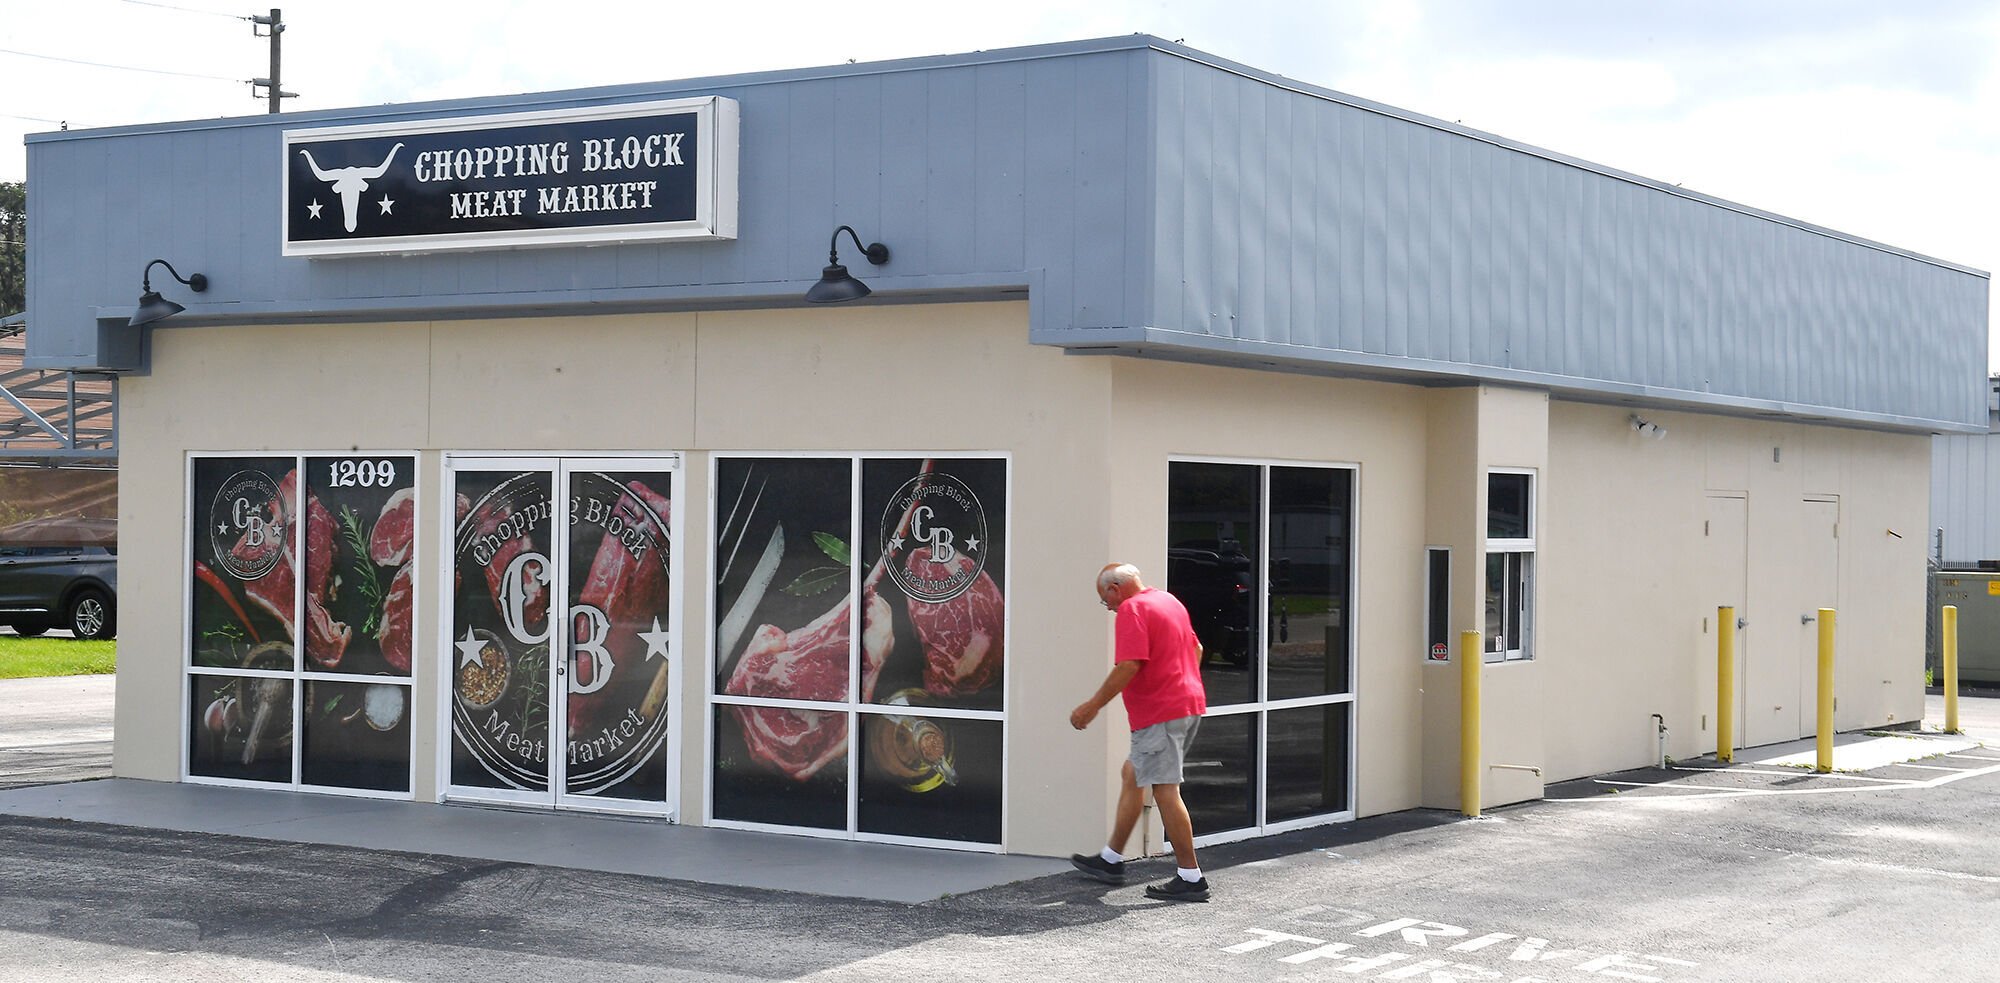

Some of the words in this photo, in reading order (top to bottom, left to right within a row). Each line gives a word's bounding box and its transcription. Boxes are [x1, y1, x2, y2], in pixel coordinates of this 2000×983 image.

[414, 142, 569, 183] CHOPPING
[582, 132, 686, 173] BLOCK
[450, 188, 528, 220] MEAT
[537, 180, 657, 214] MARKET
[329, 459, 396, 488] 1209
[900, 484, 945, 511] Chopping
[945, 486, 972, 512] Block
[473, 495, 580, 567] Choppig
[584, 498, 647, 560] Block
[901, 567, 926, 589] Meat
[483, 708, 546, 764] Meat
